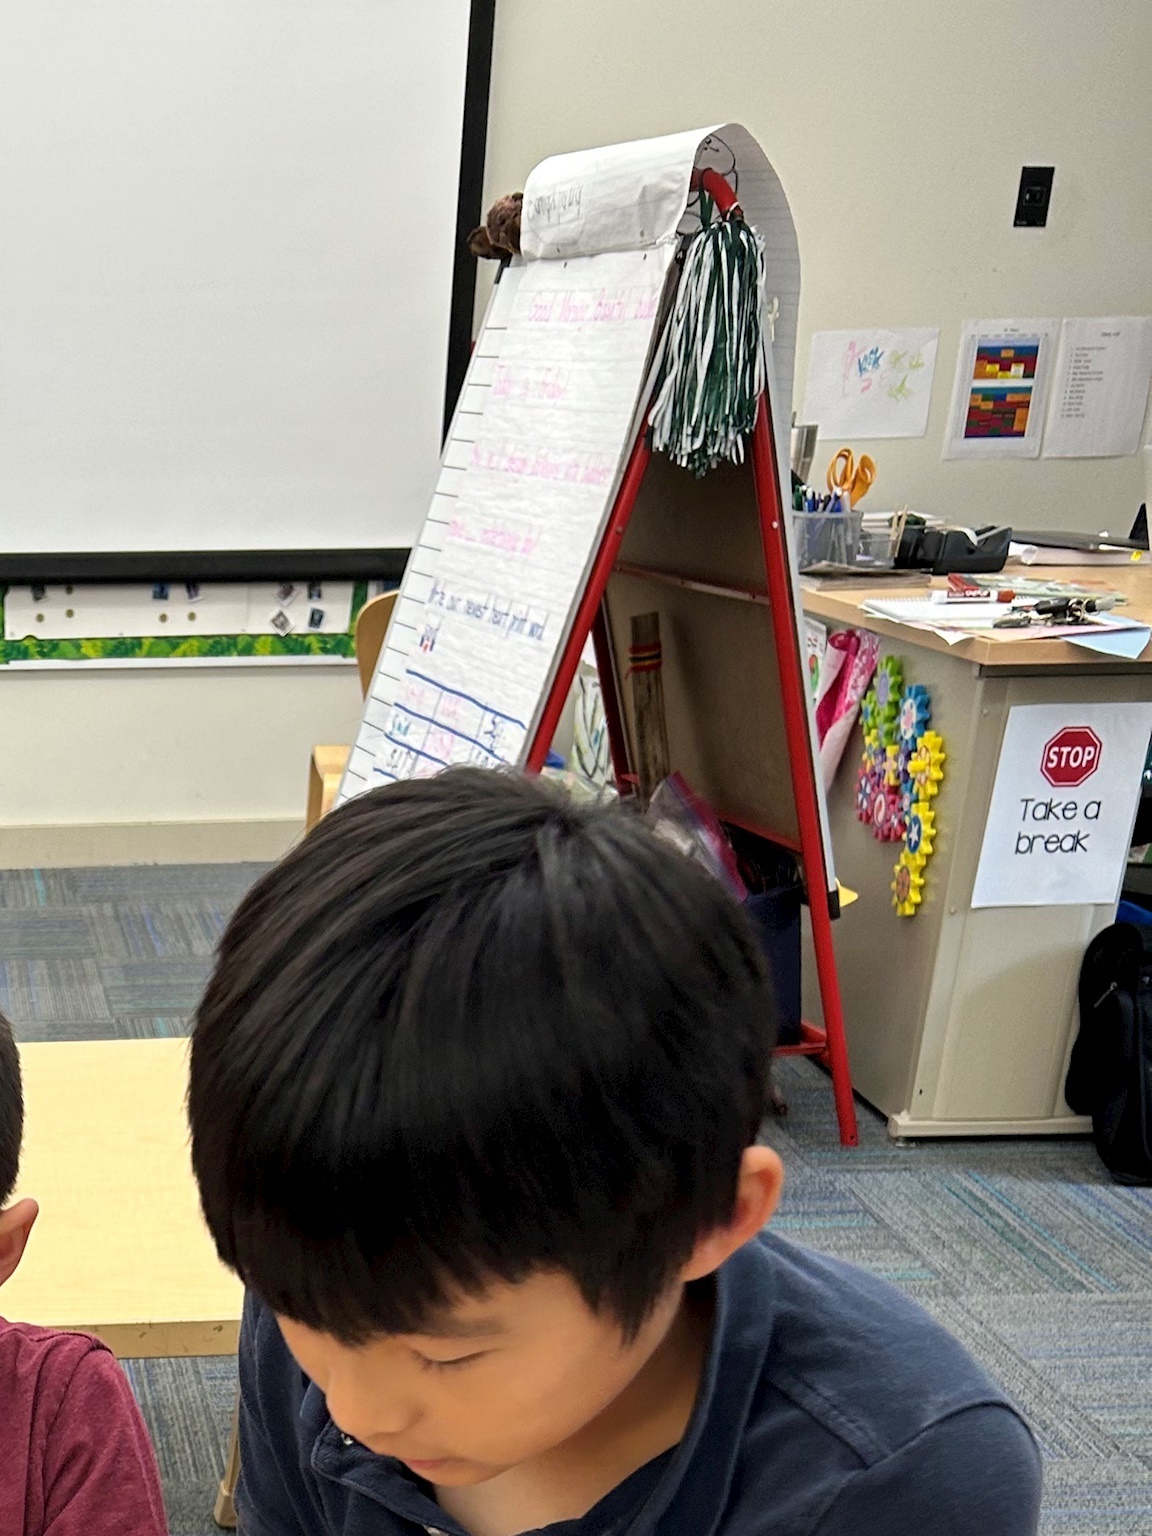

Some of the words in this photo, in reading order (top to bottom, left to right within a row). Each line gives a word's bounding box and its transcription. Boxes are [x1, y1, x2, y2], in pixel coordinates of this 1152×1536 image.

[1048, 747, 1096, 768] STOP
[1020, 798, 1078, 822] Take
[1084, 800, 1102, 821] a
[1015, 830, 1090, 854] break
